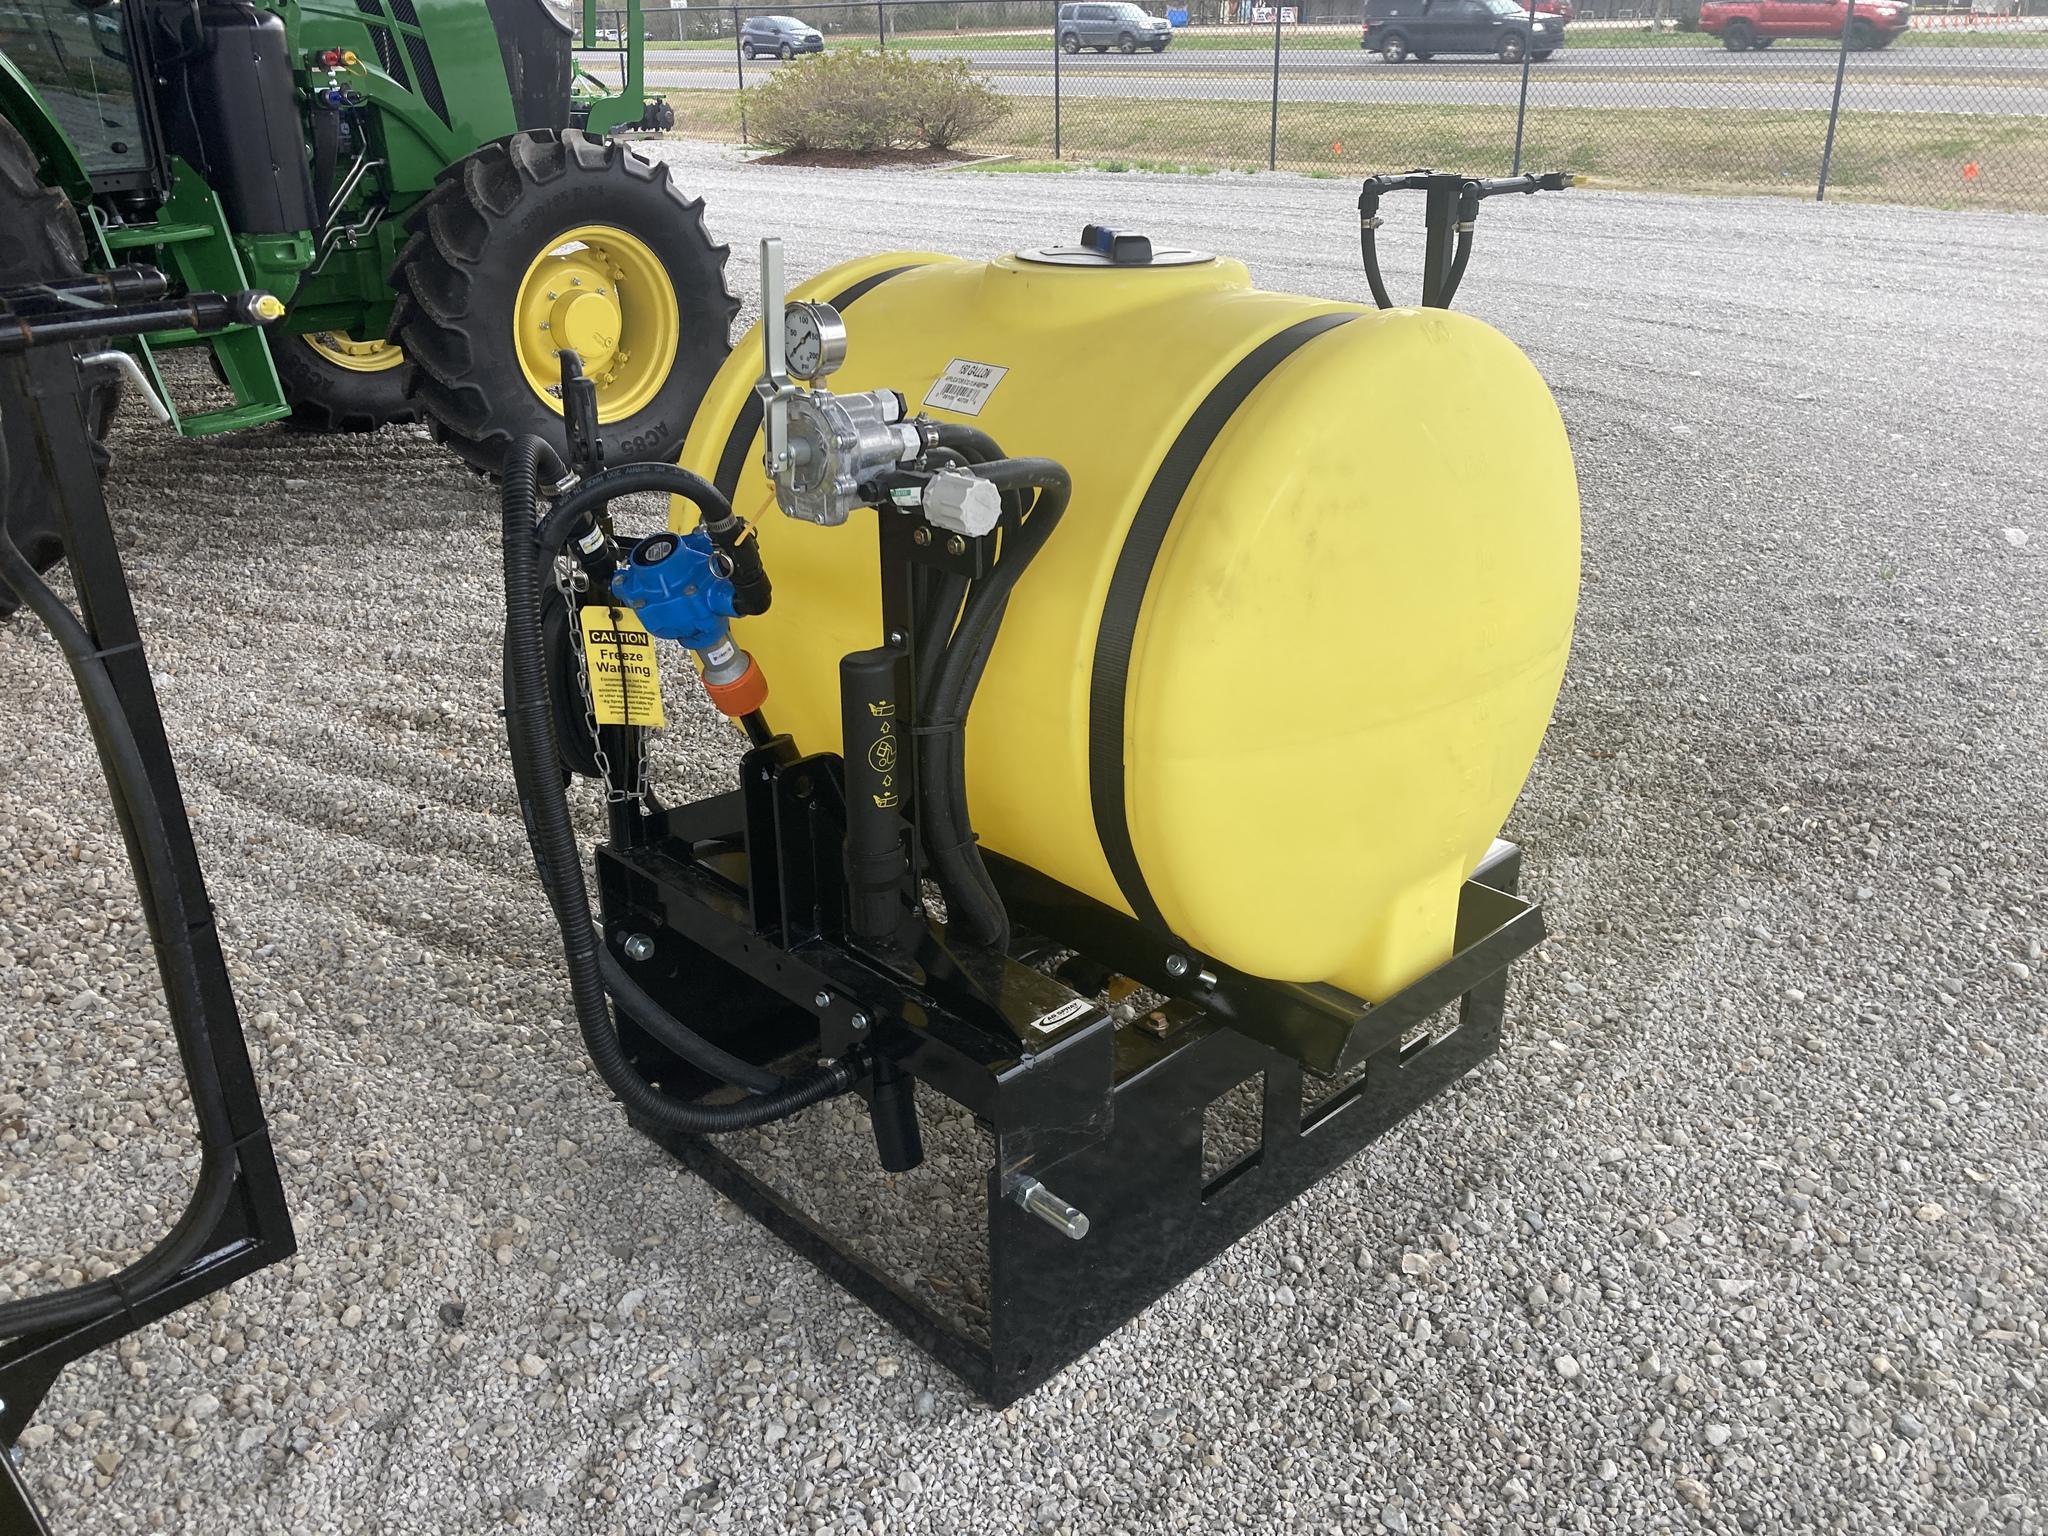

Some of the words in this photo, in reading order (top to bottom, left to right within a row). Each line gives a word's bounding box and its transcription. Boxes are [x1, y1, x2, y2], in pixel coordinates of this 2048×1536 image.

[799, 316, 809, 325] 100
[790, 329, 798, 337] 50
[809, 331, 819, 341] 150
[967, 366, 992, 379] GALLON
[621, 420, 670, 455] AC85
[591, 632, 647, 644] CAUTION
[600, 649, 643, 662] Freeze
[1056, 1002, 1078, 1015] SPRAY
